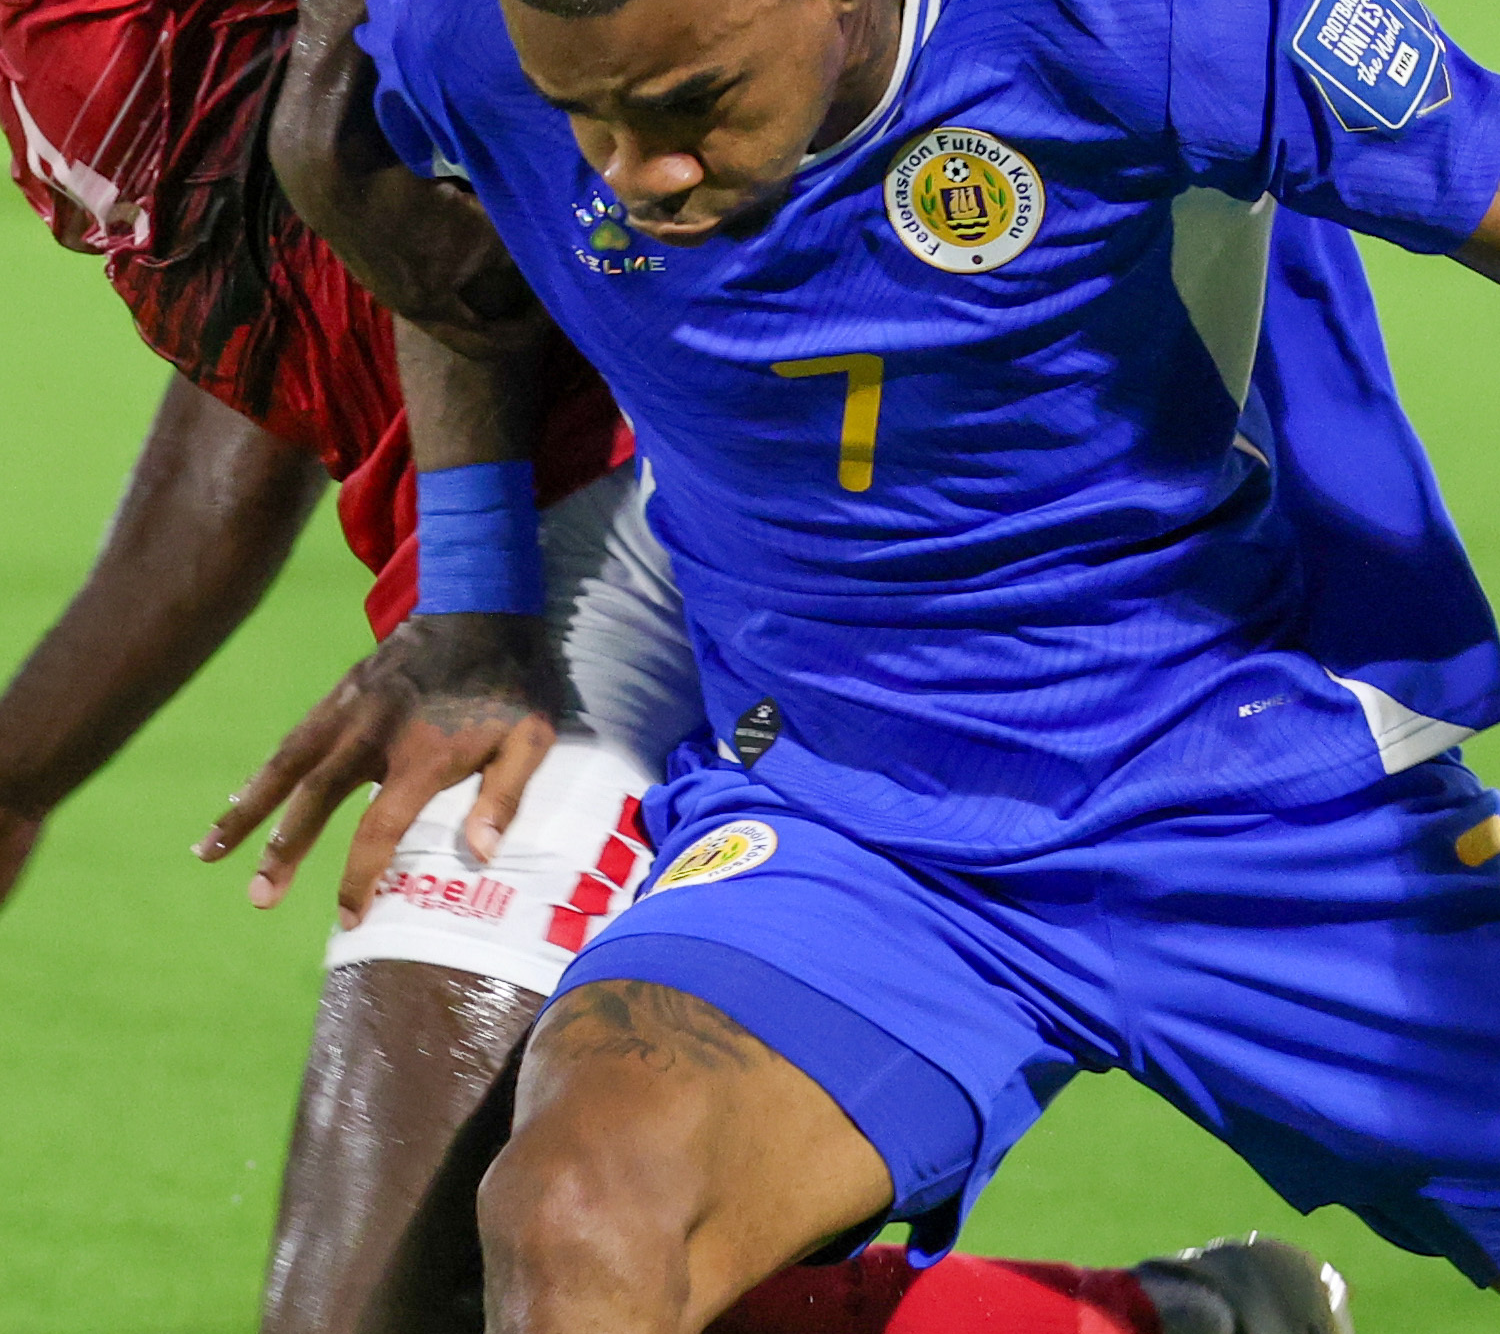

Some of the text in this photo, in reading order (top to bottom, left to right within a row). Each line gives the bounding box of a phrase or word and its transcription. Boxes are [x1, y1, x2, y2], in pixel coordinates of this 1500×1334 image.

[1357, 8, 1405, 86] the World
[1394, 51, 1413, 78] FIFA
[895, 144, 942, 256] Federashon
[769, 351, 885, 493] 7
